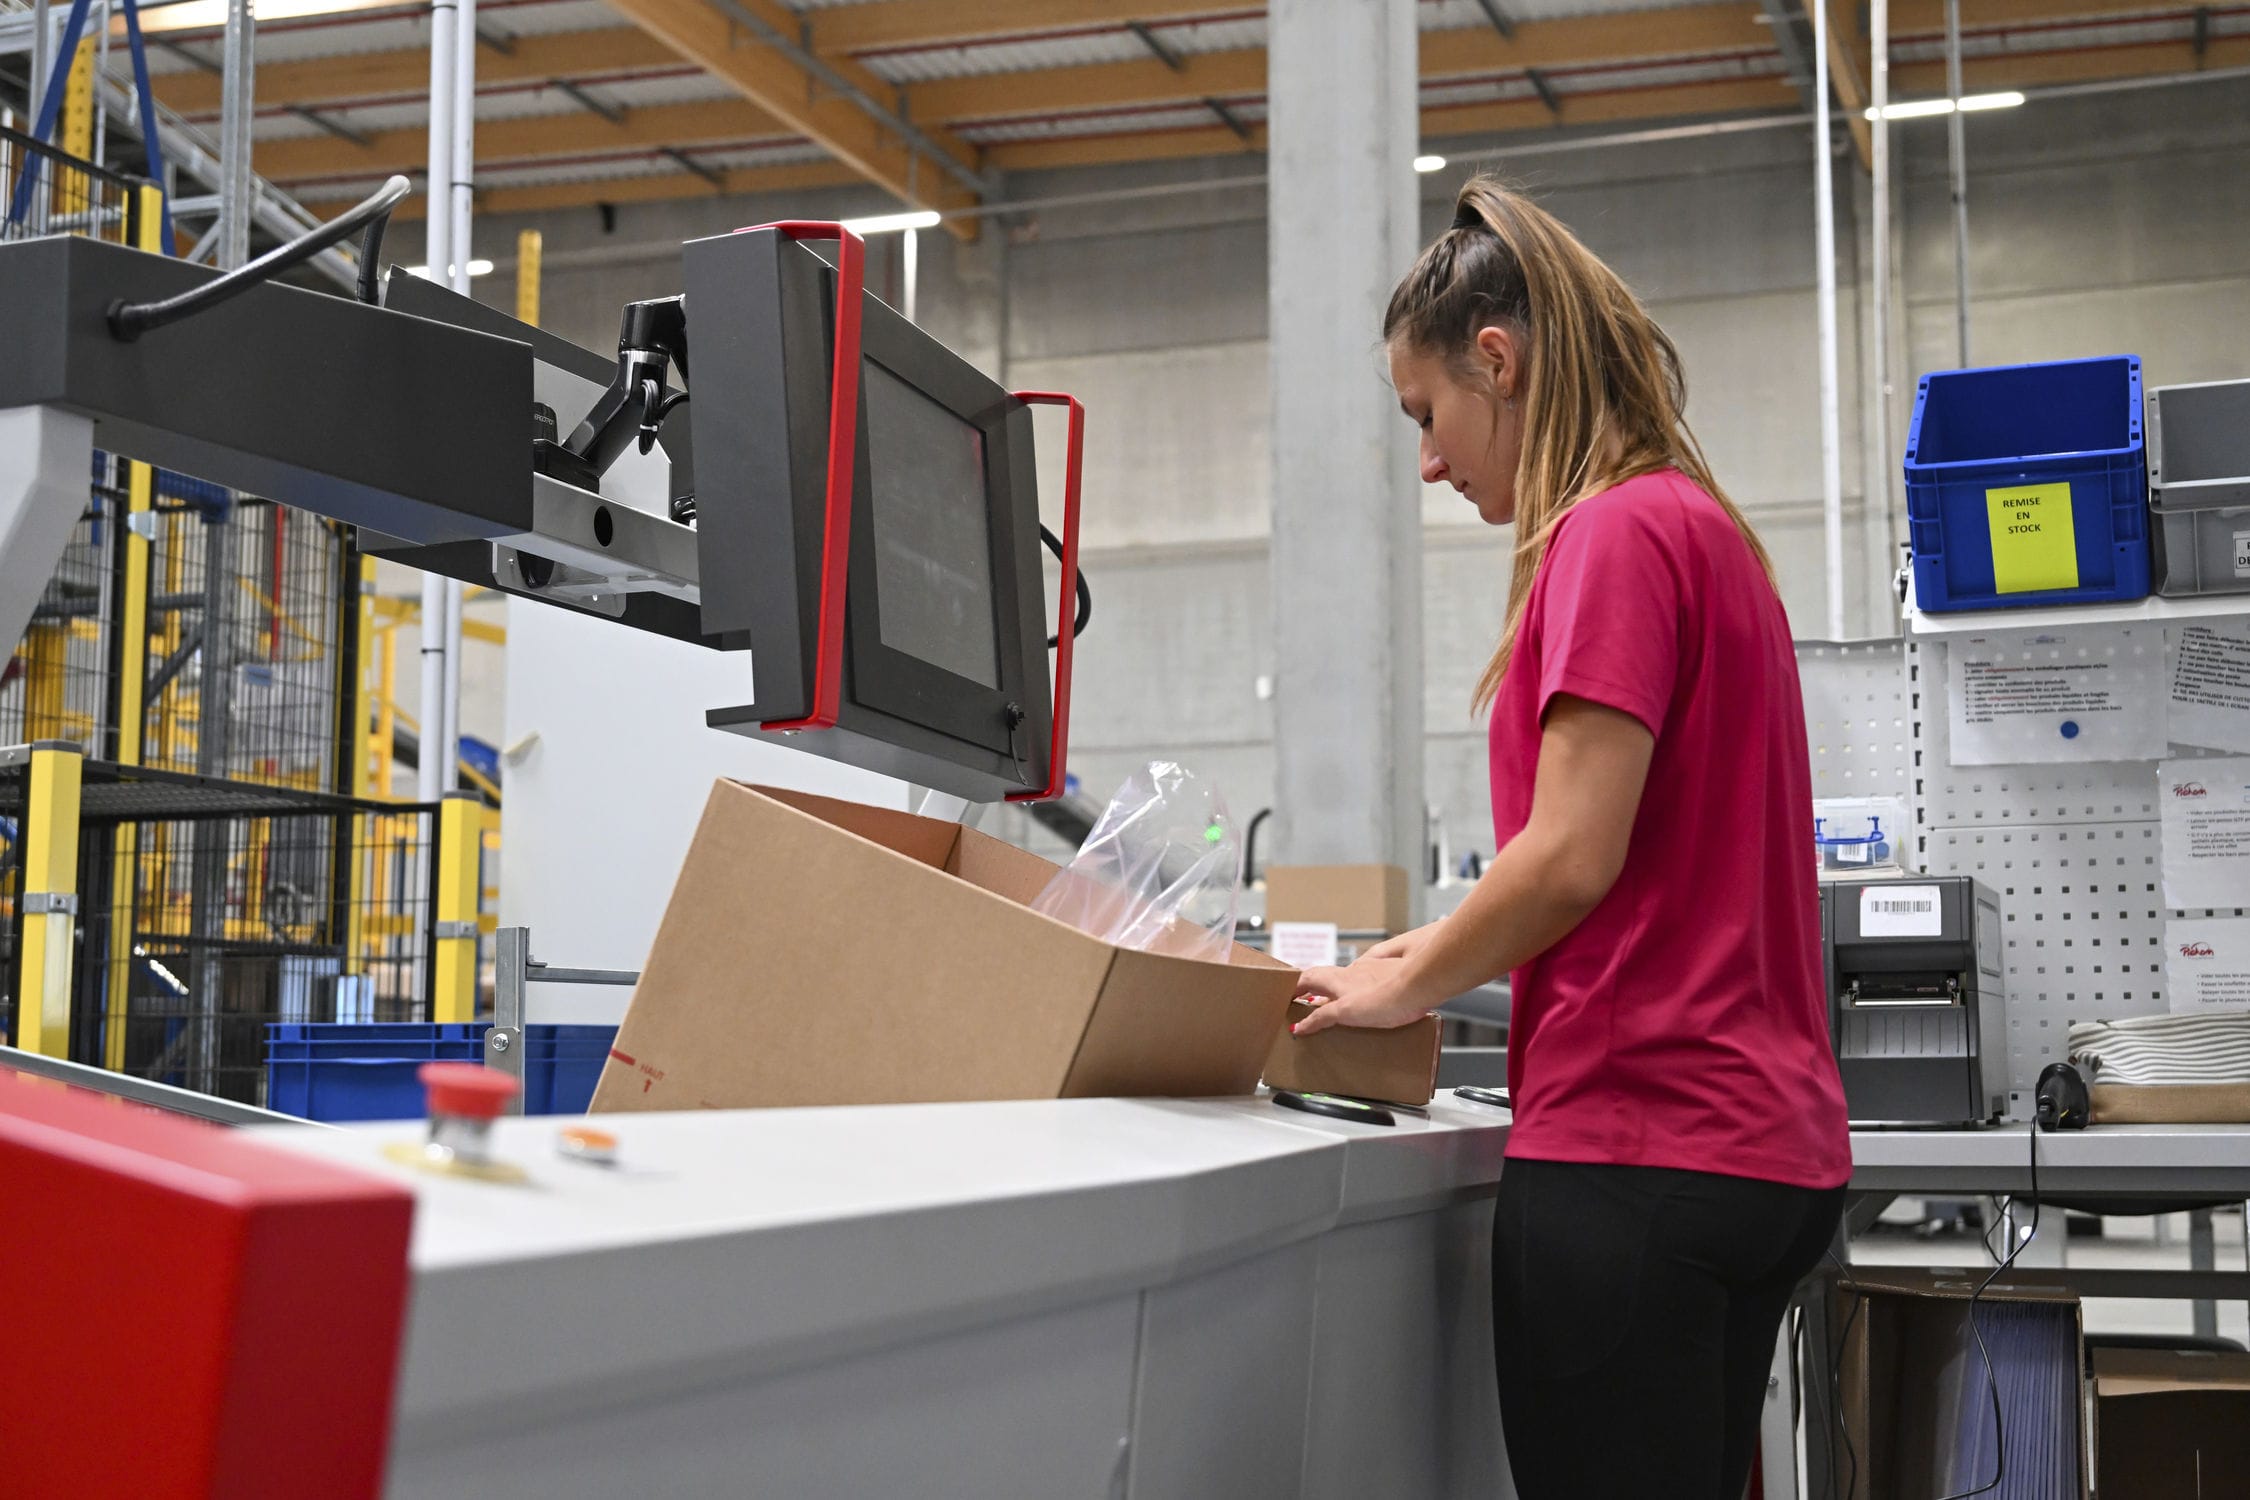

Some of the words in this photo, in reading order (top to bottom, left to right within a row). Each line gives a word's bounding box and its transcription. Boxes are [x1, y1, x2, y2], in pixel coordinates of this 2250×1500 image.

[2003, 497, 2040, 508] REMISE
[2017, 512, 2030, 520] EN
[2008, 524, 2041, 534] STOCK
[640, 1064, 664, 1080] HAUT
